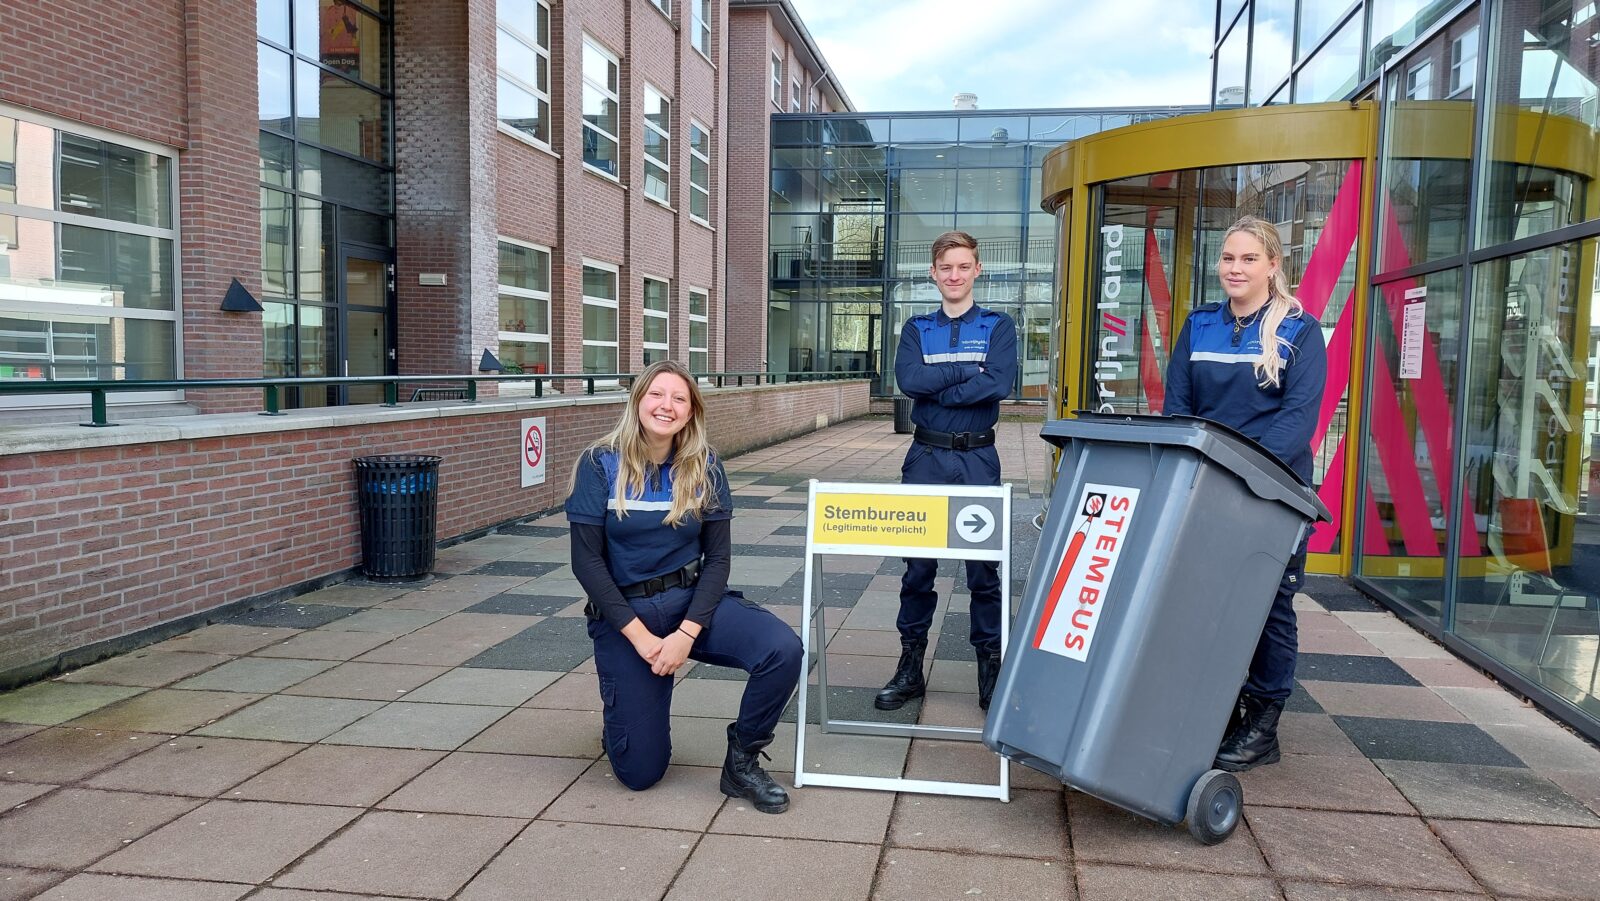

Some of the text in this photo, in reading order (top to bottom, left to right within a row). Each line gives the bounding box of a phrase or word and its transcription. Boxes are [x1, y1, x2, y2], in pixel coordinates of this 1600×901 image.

[824, 505, 927, 522] Stembureau
[822, 523, 927, 536] (Legitimatie verplicht)
[1064, 495, 1129, 651] STEMBUS
